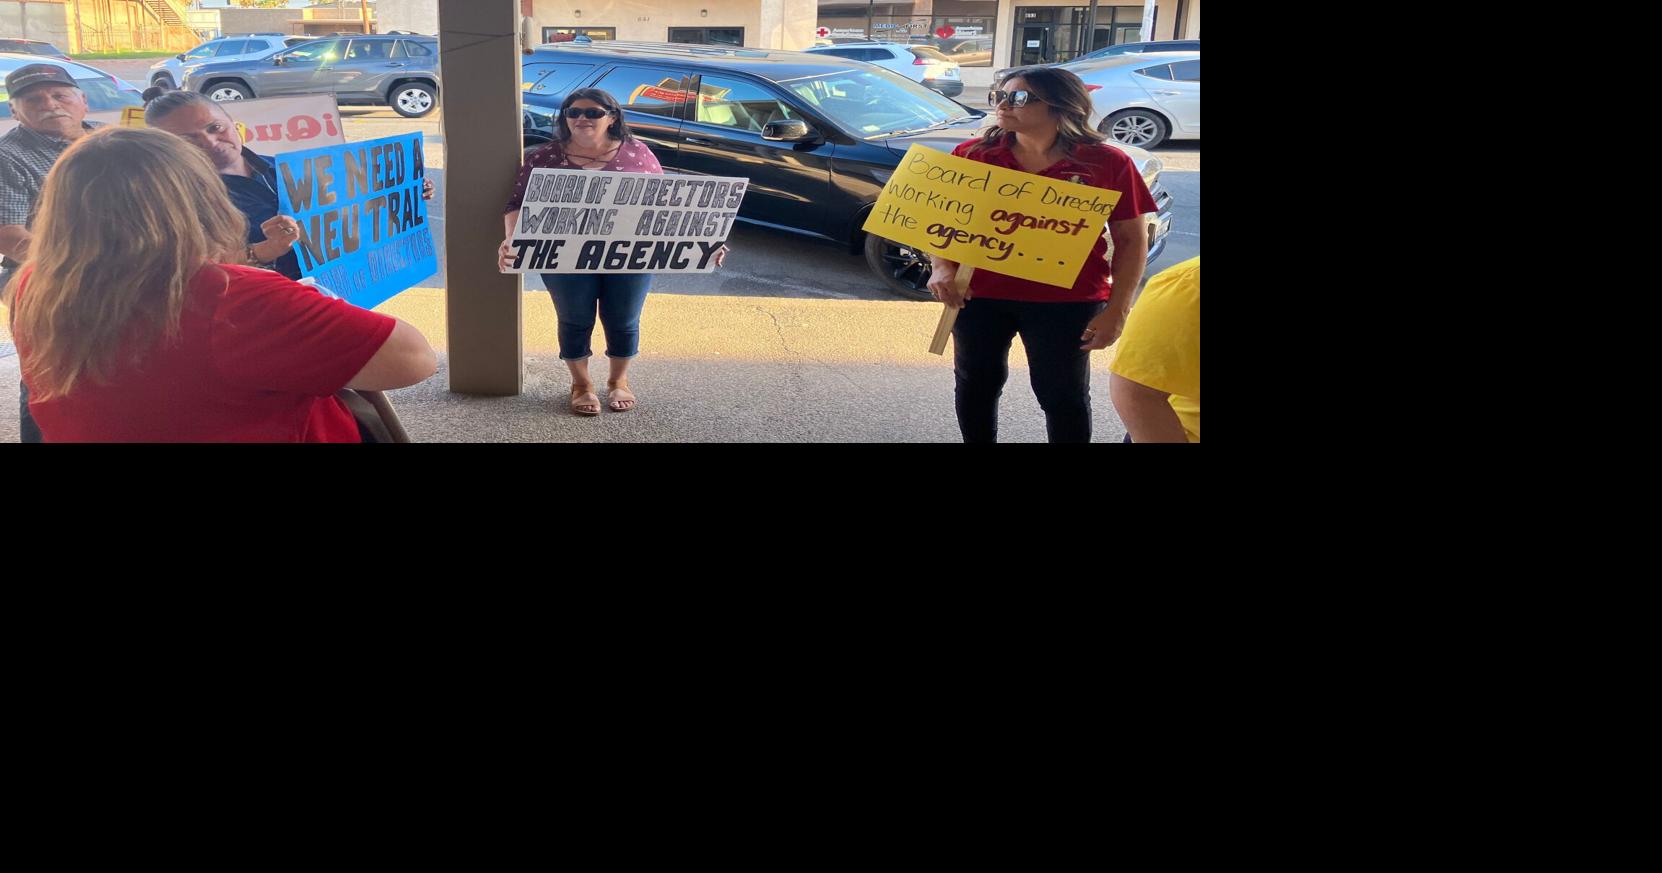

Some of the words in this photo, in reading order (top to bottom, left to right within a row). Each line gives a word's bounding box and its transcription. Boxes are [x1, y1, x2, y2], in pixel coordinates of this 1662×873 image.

[279, 155, 336, 213] WE
[344, 142, 406, 199] NEED
[413, 138, 424, 180] A
[526, 173, 587, 204] BOARD
[585, 175, 612, 205] OF
[612, 177, 745, 209] DIRECTORS
[907, 152, 992, 192] Board
[998, 181, 1034, 200] of
[1040, 185, 1115, 216] Directors
[297, 185, 424, 272] NEUTRAL
[521, 206, 618, 236] WORKING
[634, 209, 737, 237] AGAINST
[880, 204, 918, 230] the
[990, 208, 1089, 236] against
[367, 227, 433, 282] DIRECTORS
[512, 239, 566, 270] THE
[575, 240, 725, 271] AGENCY
